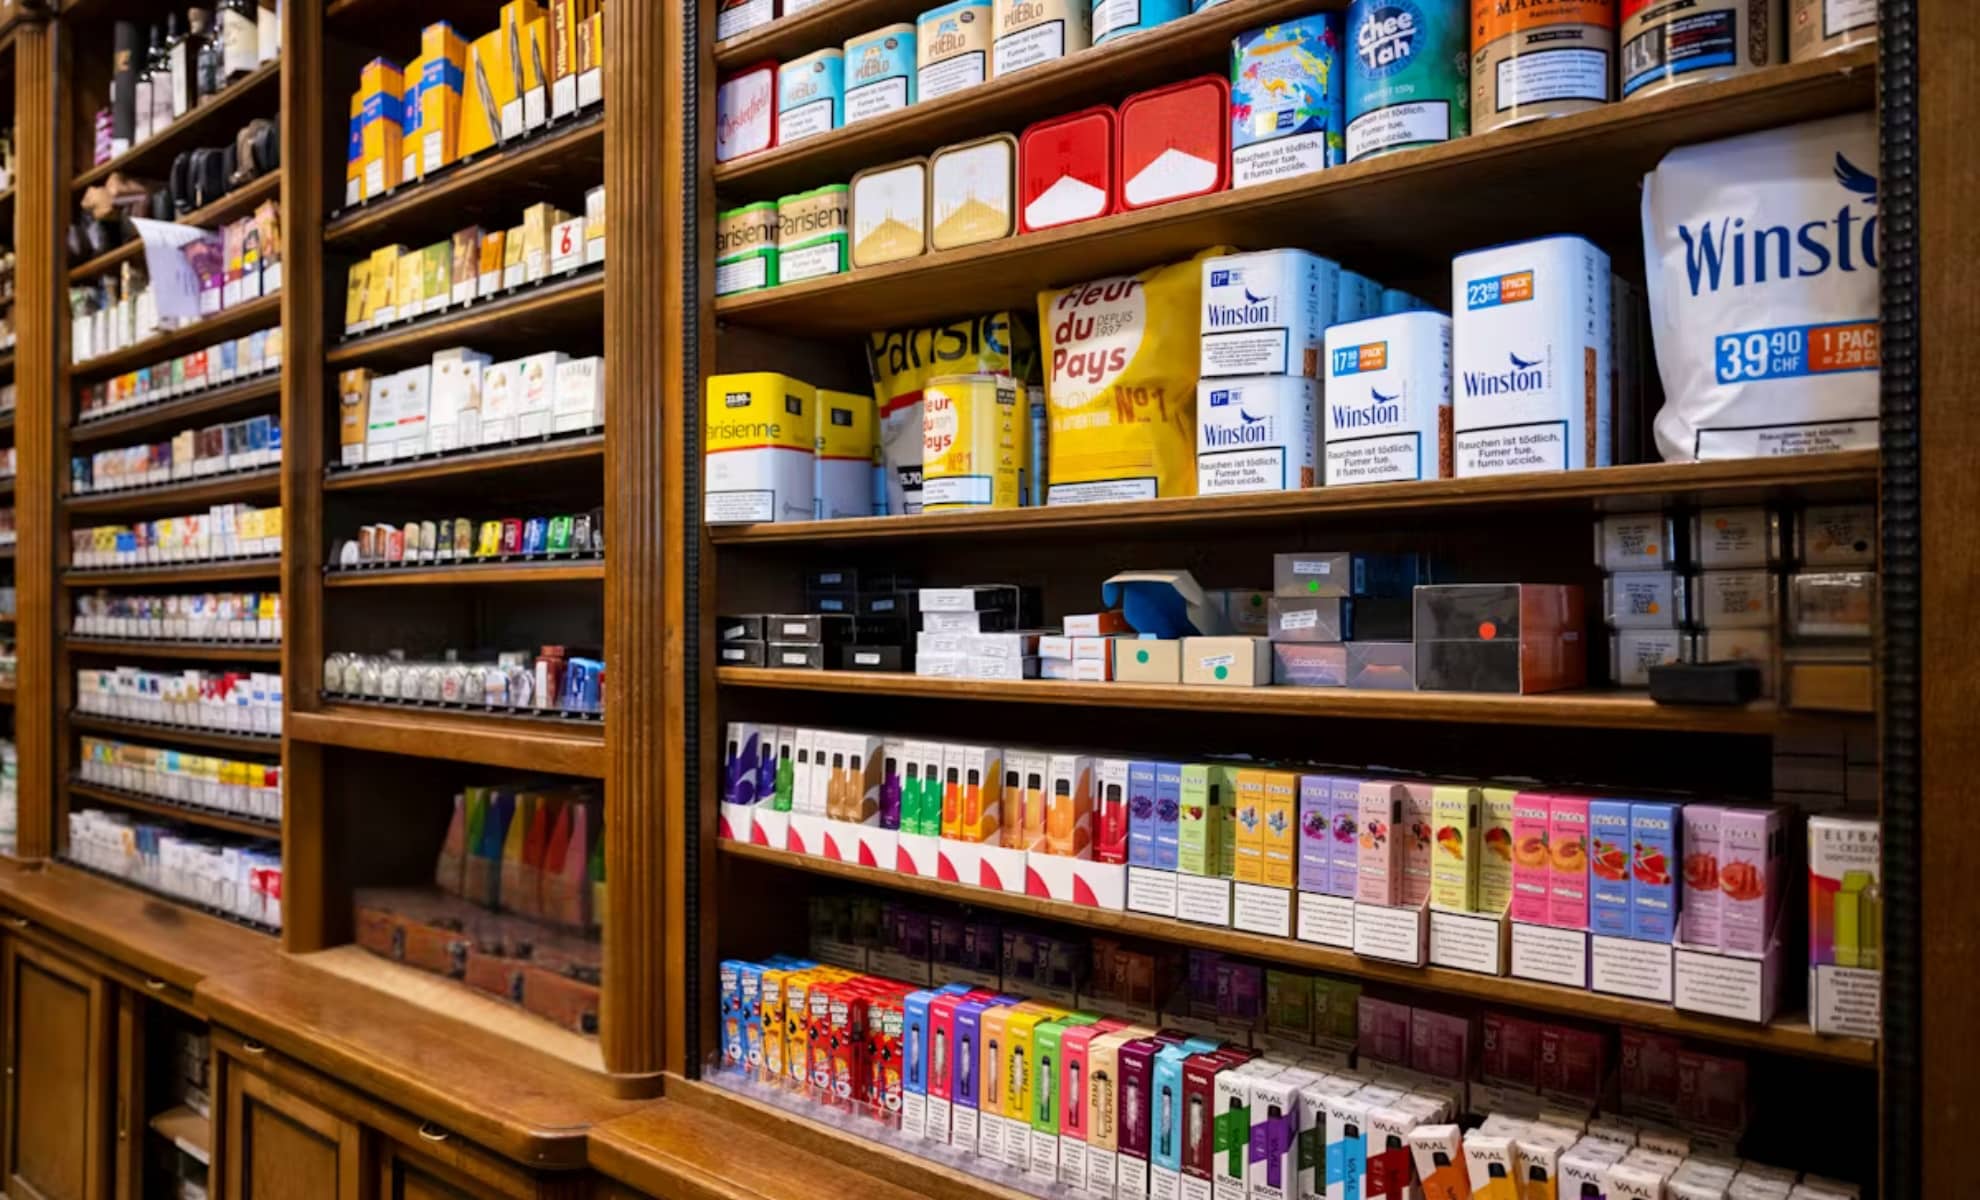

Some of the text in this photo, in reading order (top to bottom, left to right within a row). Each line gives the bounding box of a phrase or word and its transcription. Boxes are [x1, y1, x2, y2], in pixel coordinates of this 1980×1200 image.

[1004, 3, 1043, 27] PUEBLO
[1359, 12, 1413, 47] Chee
[929, 33, 965, 57] PUEBLO
[1362, 35, 1411, 69] Tah
[1468, 285, 1488, 305] 23
[1208, 303, 1269, 326] Winston
[1056, 311, 1094, 345] du
[1334, 352, 1347, 373] 17
[1720, 334, 1769, 380] 39
[1772, 357, 1801, 372] CHF
[1052, 347, 1127, 384] Pays
[1464, 369, 1542, 397] Winston
[1333, 404, 1398, 428] Winston
[706, 420, 780, 440] arisienne
[1204, 424, 1266, 446] Winston
[1503, 436, 1517, 446] ist
[1519, 432, 1560, 444] tödlich.
[1378, 443, 1413, 454] tödlich.
[1479, 446, 1535, 459] Fumer tue.
[1246, 455, 1279, 467] tödlich.
[1344, 457, 1373, 467] Fumer
[1477, 457, 1504, 468] fumo
[1507, 455, 1545, 466] uccide.
[1215, 467, 1242, 478] Fumer
[1343, 467, 1366, 477] fumo
[1368, 464, 1400, 474] uccide.
[1238, 474, 1267, 486] uccide.
[1218, 1082, 1243, 1098] VAAL
[1256, 1090, 1283, 1106] VAAL
[1331, 1108, 1361, 1124] VAAL
[1373, 1120, 1404, 1136] VAAL
[1415, 1140, 1448, 1150] VAAL
[1471, 1150, 1505, 1161] VAAL
[1565, 1166, 1600, 1183] VAAL
[1614, 1180, 1651, 1197] VAAL
